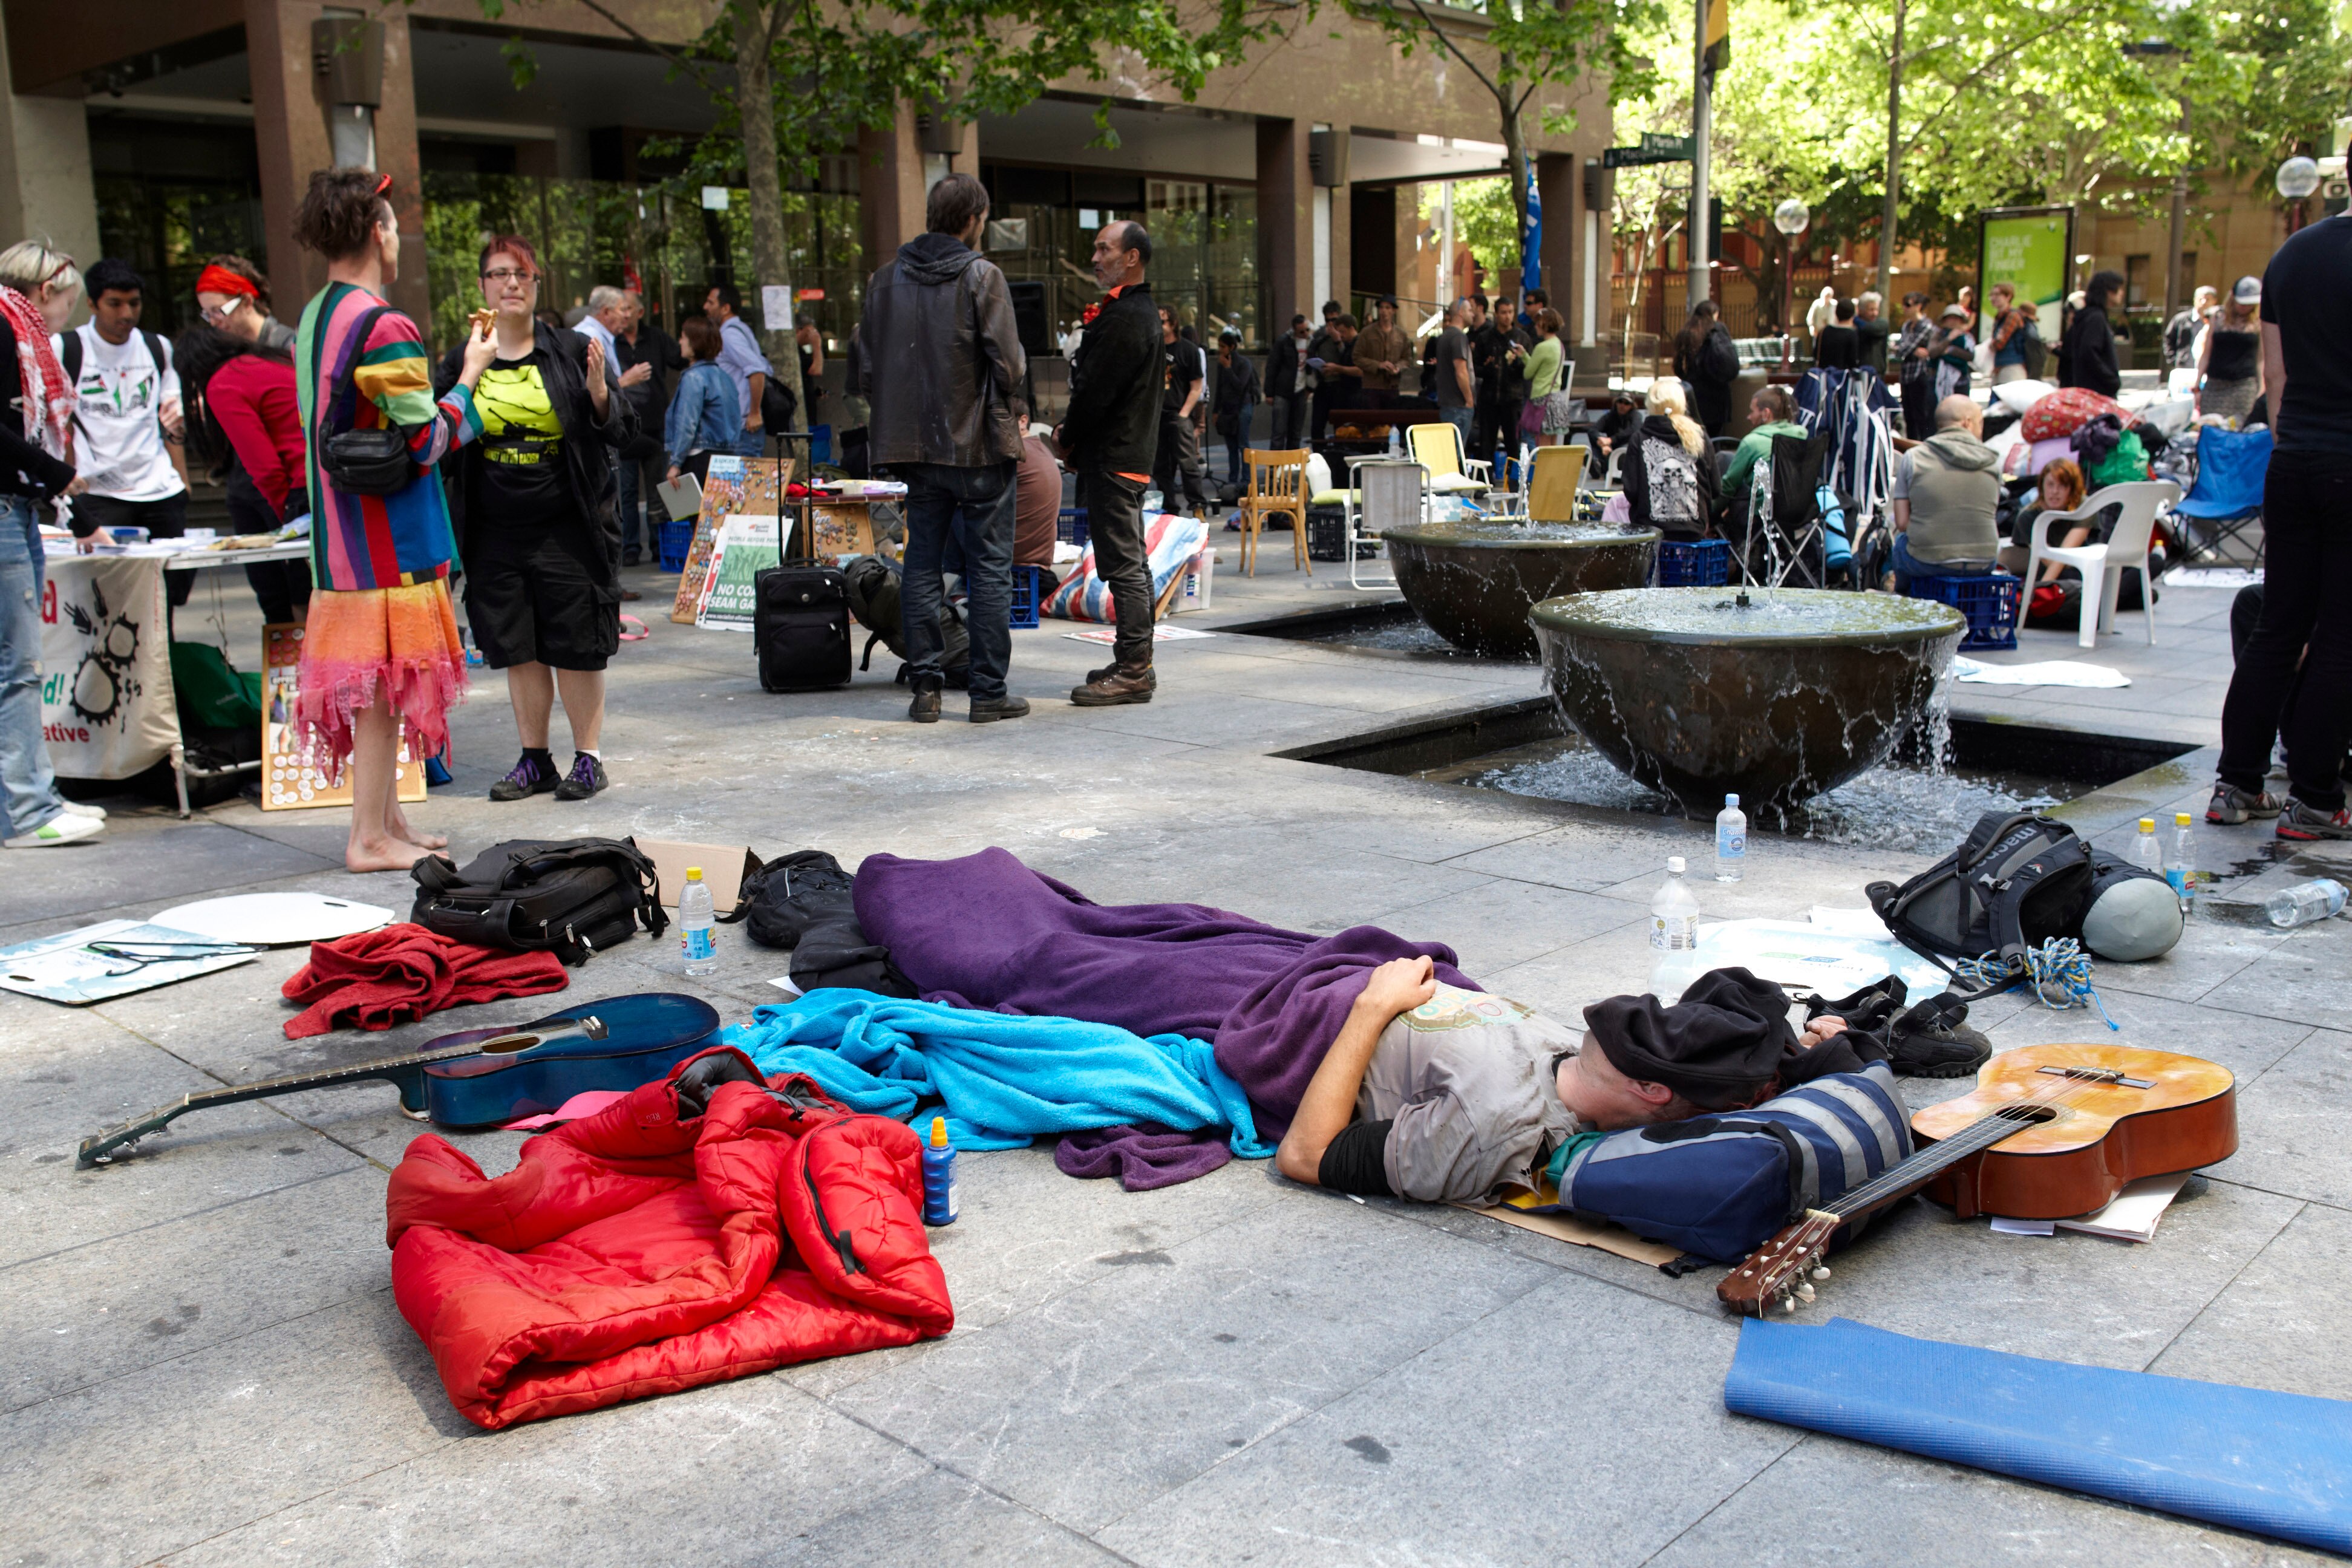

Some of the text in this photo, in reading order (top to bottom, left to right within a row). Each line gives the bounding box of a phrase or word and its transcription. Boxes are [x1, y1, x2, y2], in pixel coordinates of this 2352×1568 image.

[716, 584, 756, 597] NO COA
[709, 596, 736, 609] SEAM
[739, 598, 756, 610] GA
[43, 722, 90, 743] ative
